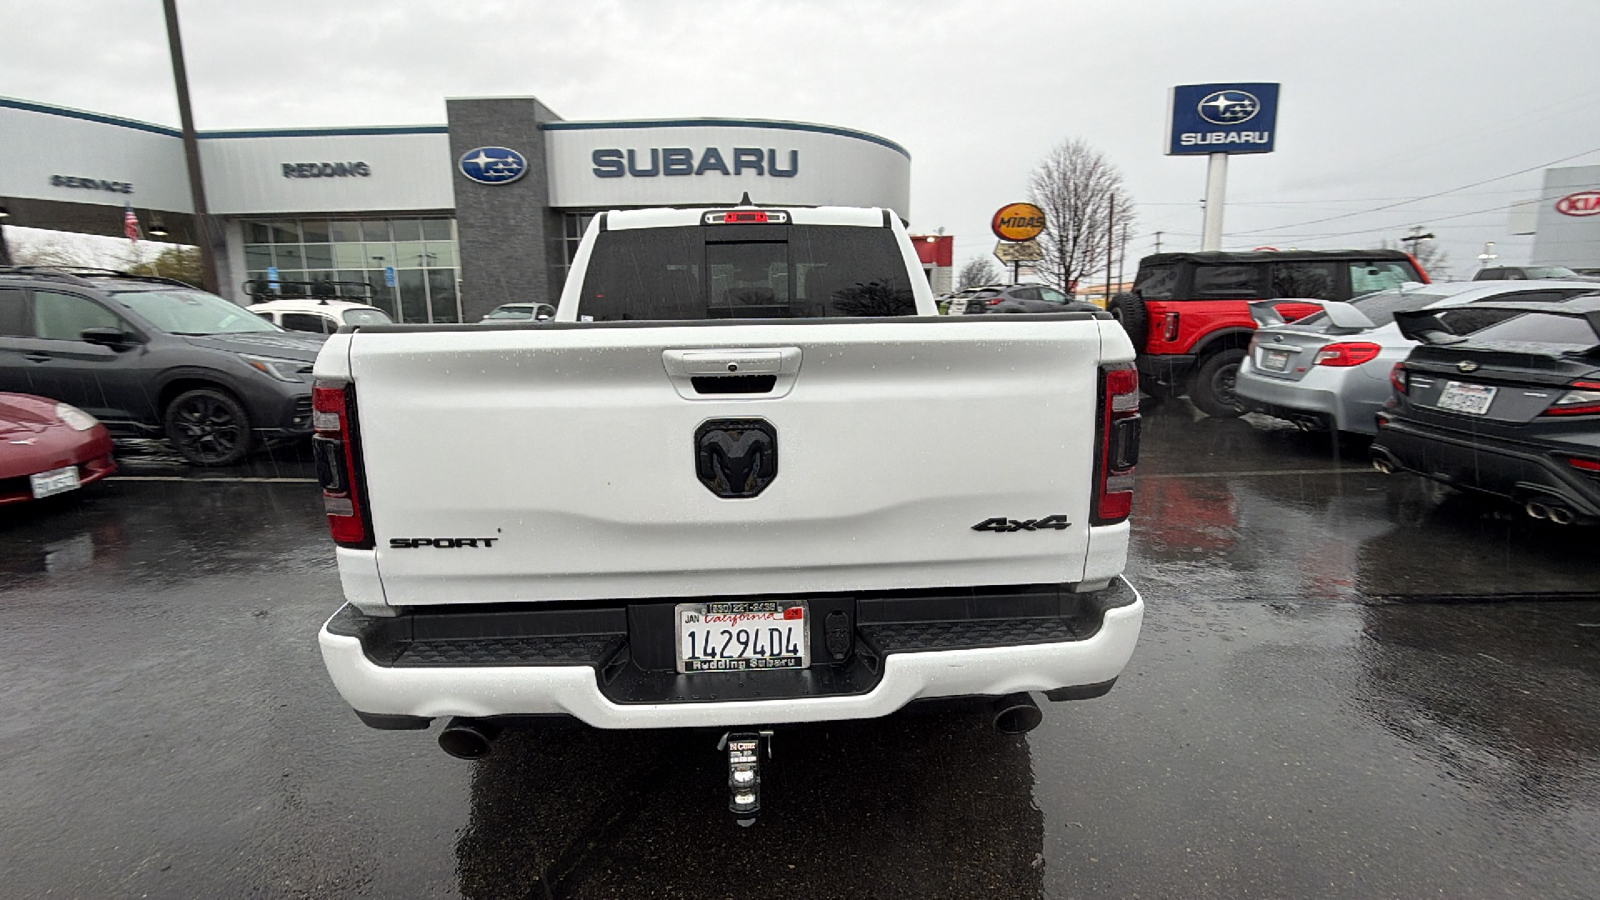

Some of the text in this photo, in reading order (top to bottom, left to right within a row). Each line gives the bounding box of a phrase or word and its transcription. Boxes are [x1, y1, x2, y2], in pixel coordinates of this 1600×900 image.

[1180, 131, 1269, 145] SUBARU
[281, 161, 370, 178] REDDING
[593, 147, 799, 178] SUBARU
[999, 216, 1045, 228] MIDAS
[971, 514, 1072, 532] 4x4
[389, 538, 498, 548] SPORT
[685, 615, 700, 623] JAN
[704, 613, 783, 627] California
[688, 627, 799, 659] 14294D4
[692, 658, 796, 671] Redding Subaru
